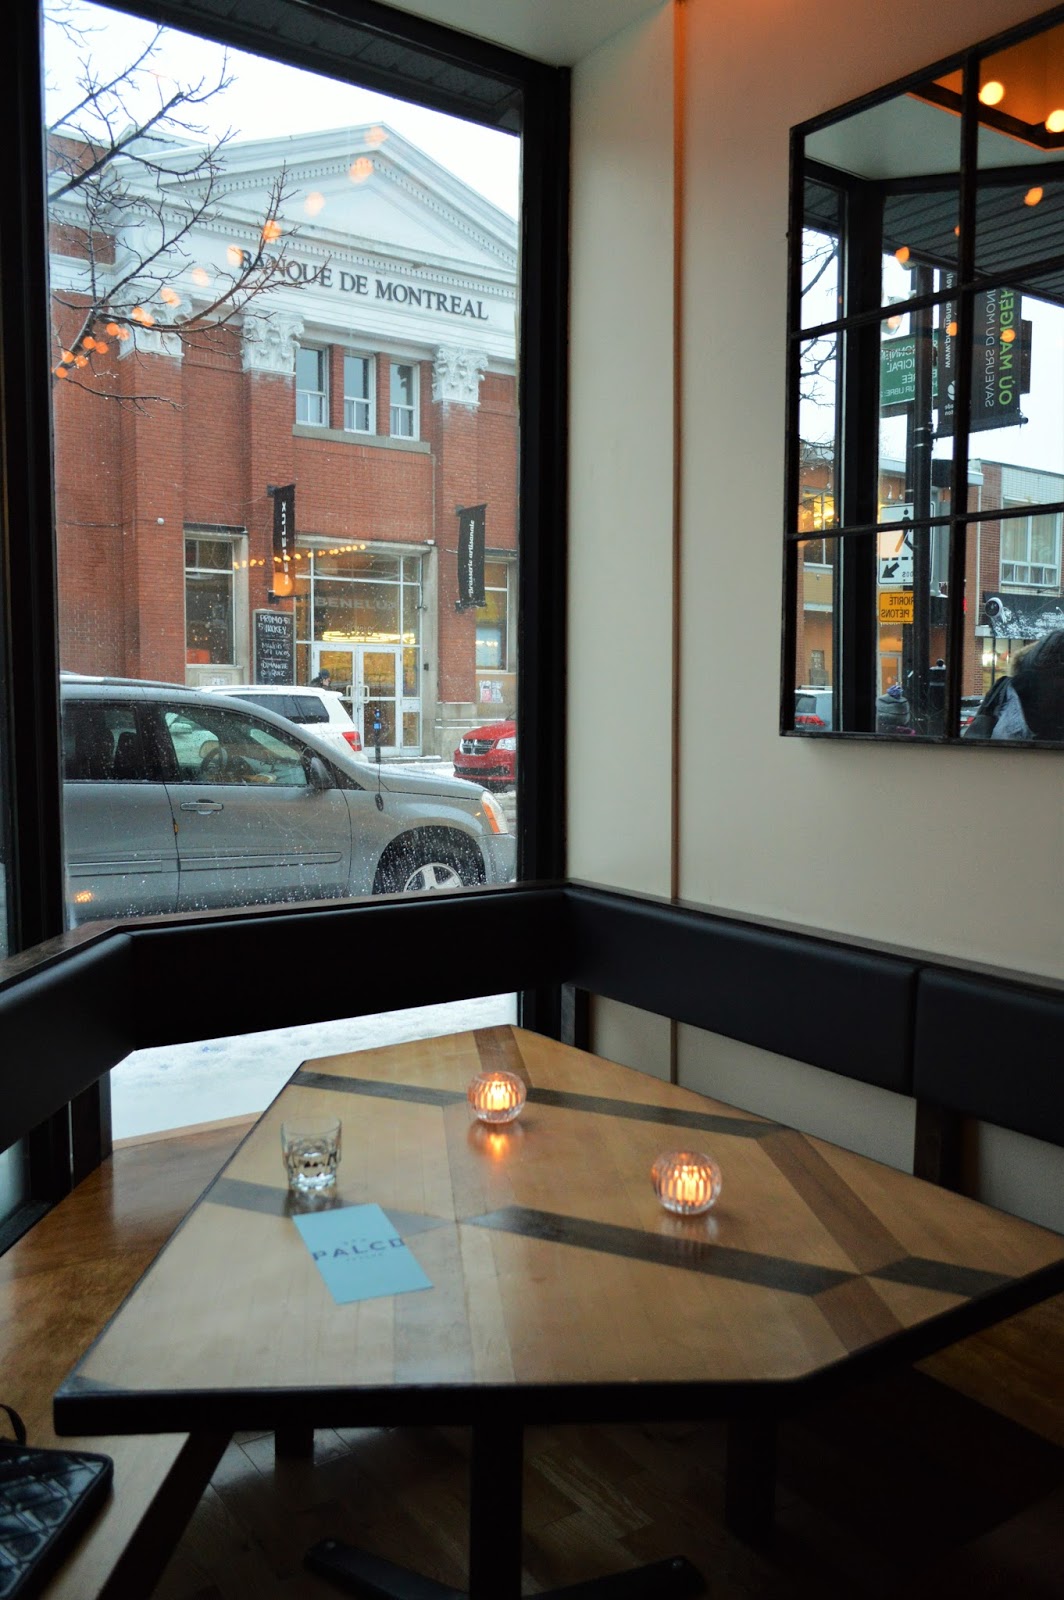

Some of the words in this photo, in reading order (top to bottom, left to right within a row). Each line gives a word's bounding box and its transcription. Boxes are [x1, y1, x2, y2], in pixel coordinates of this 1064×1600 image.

[240, 250, 333, 288] BANQUE
[339, 271, 369, 295] DE
[375, 279, 489, 320] MONTREAL
